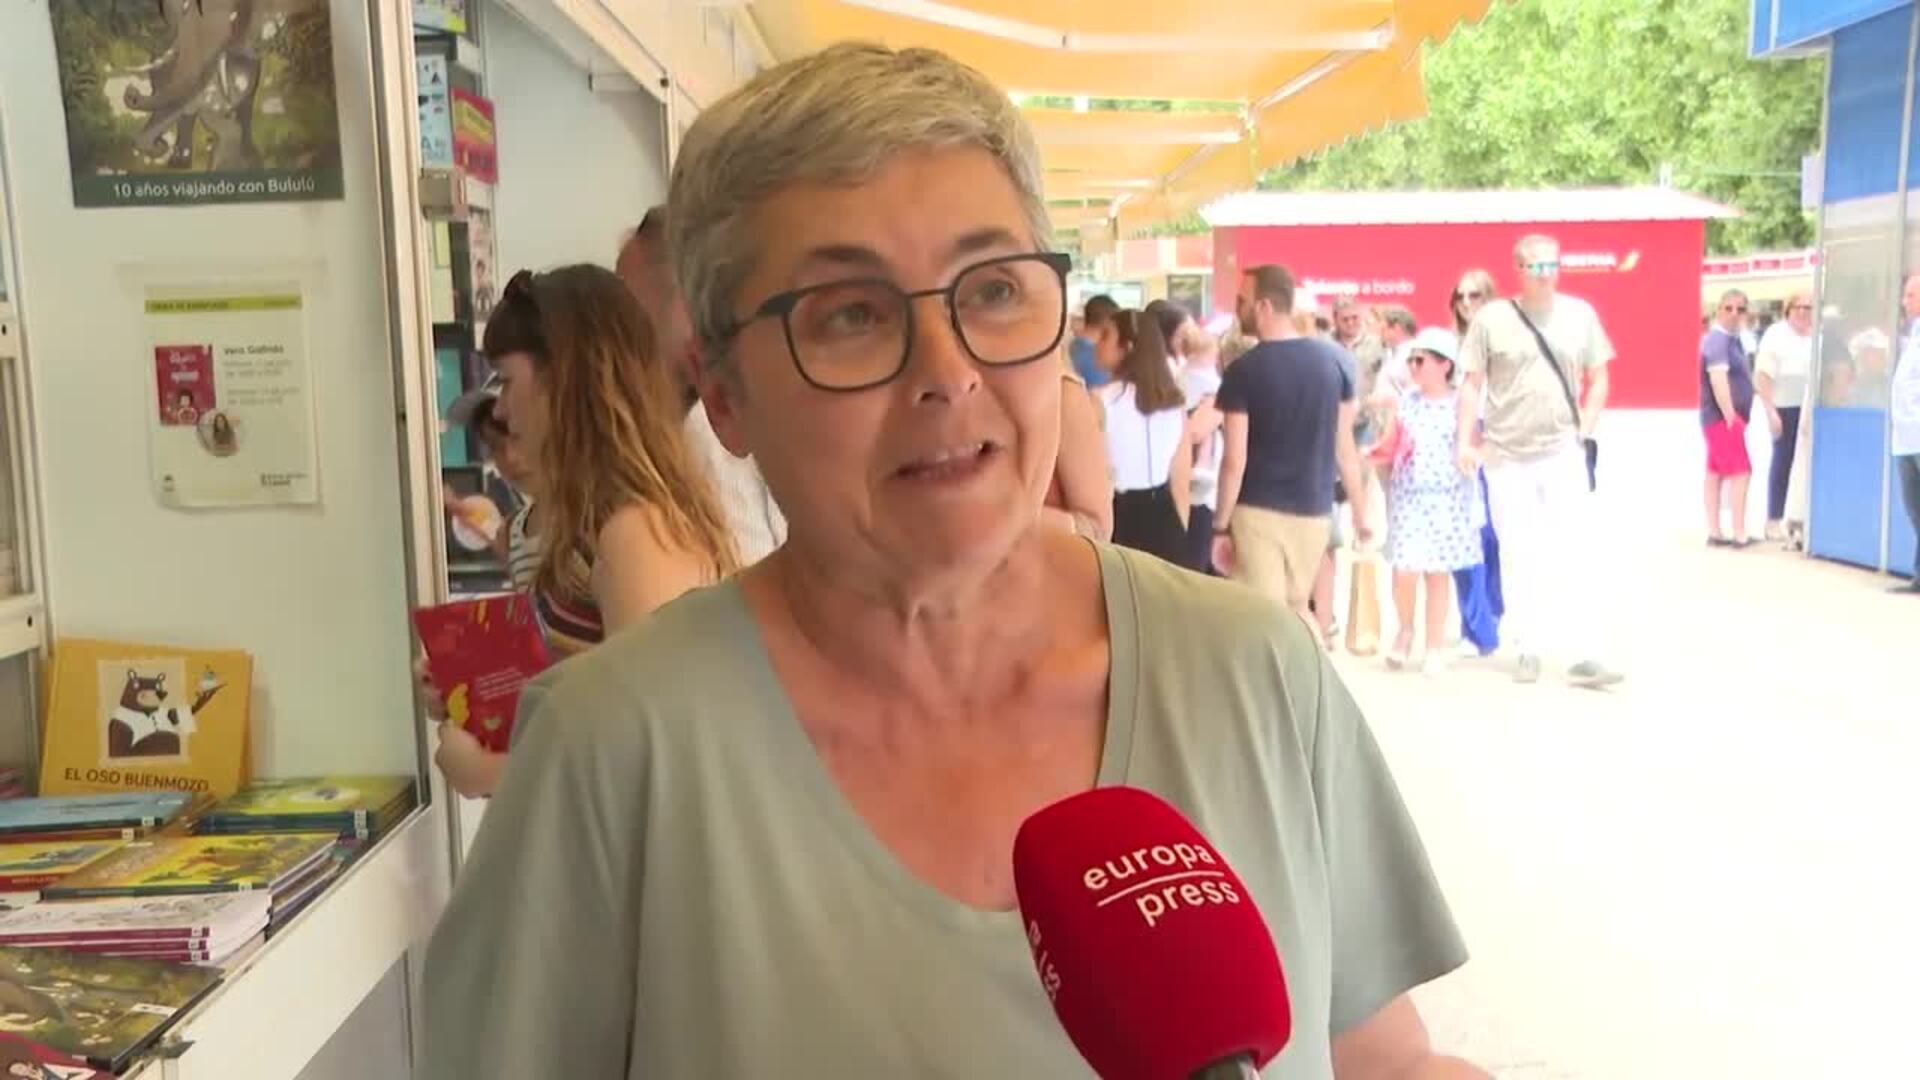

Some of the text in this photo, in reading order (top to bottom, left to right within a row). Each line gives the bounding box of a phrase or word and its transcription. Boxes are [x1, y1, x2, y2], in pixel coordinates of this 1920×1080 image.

[113, 176, 315, 198] 10 años viajando con Bululú
[1361, 283, 1371, 295] a
[1373, 278, 1415, 295] bordo
[64, 767, 209, 792] EL OSO BUENMOZO
[1083, 842, 1217, 890] europa
[1135, 880, 1240, 927] press
